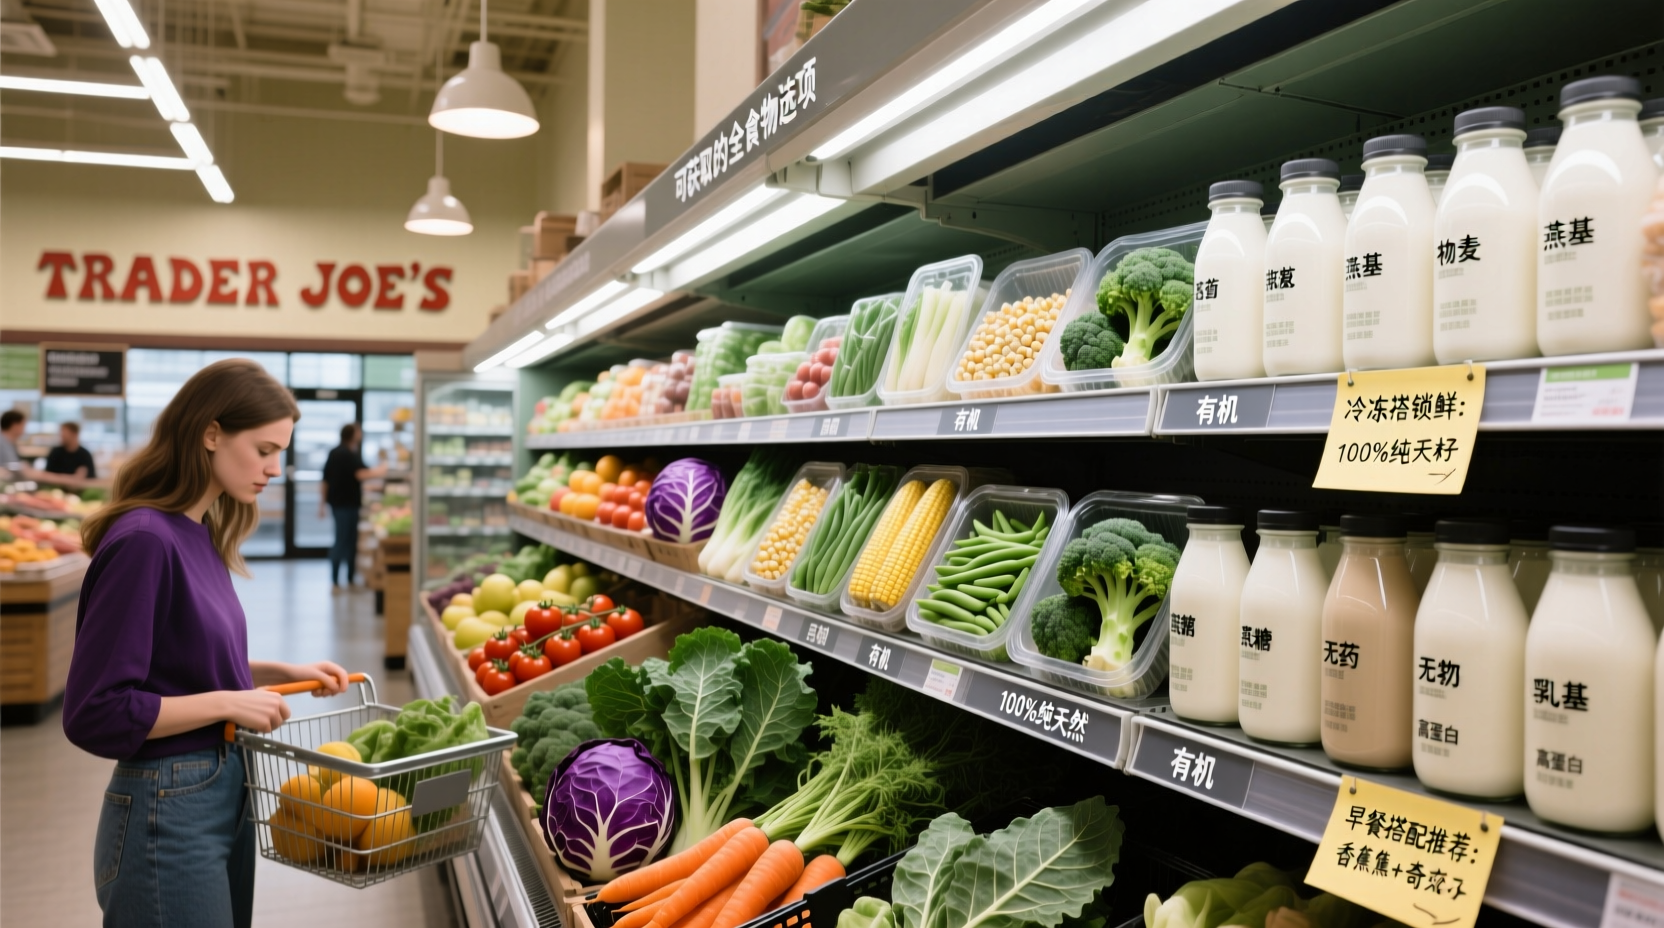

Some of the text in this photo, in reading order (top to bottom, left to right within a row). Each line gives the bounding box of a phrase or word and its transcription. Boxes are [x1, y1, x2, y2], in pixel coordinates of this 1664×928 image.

[37, 251, 280, 306] TRADER
[300, 261, 453, 312] JOE'S
[954, 407, 981, 432] 有机
[1196, 394, 1238, 425] 有机
[1000, 690, 1089, 743] 100%纯天然
[1170, 746, 1216, 790] 有机
